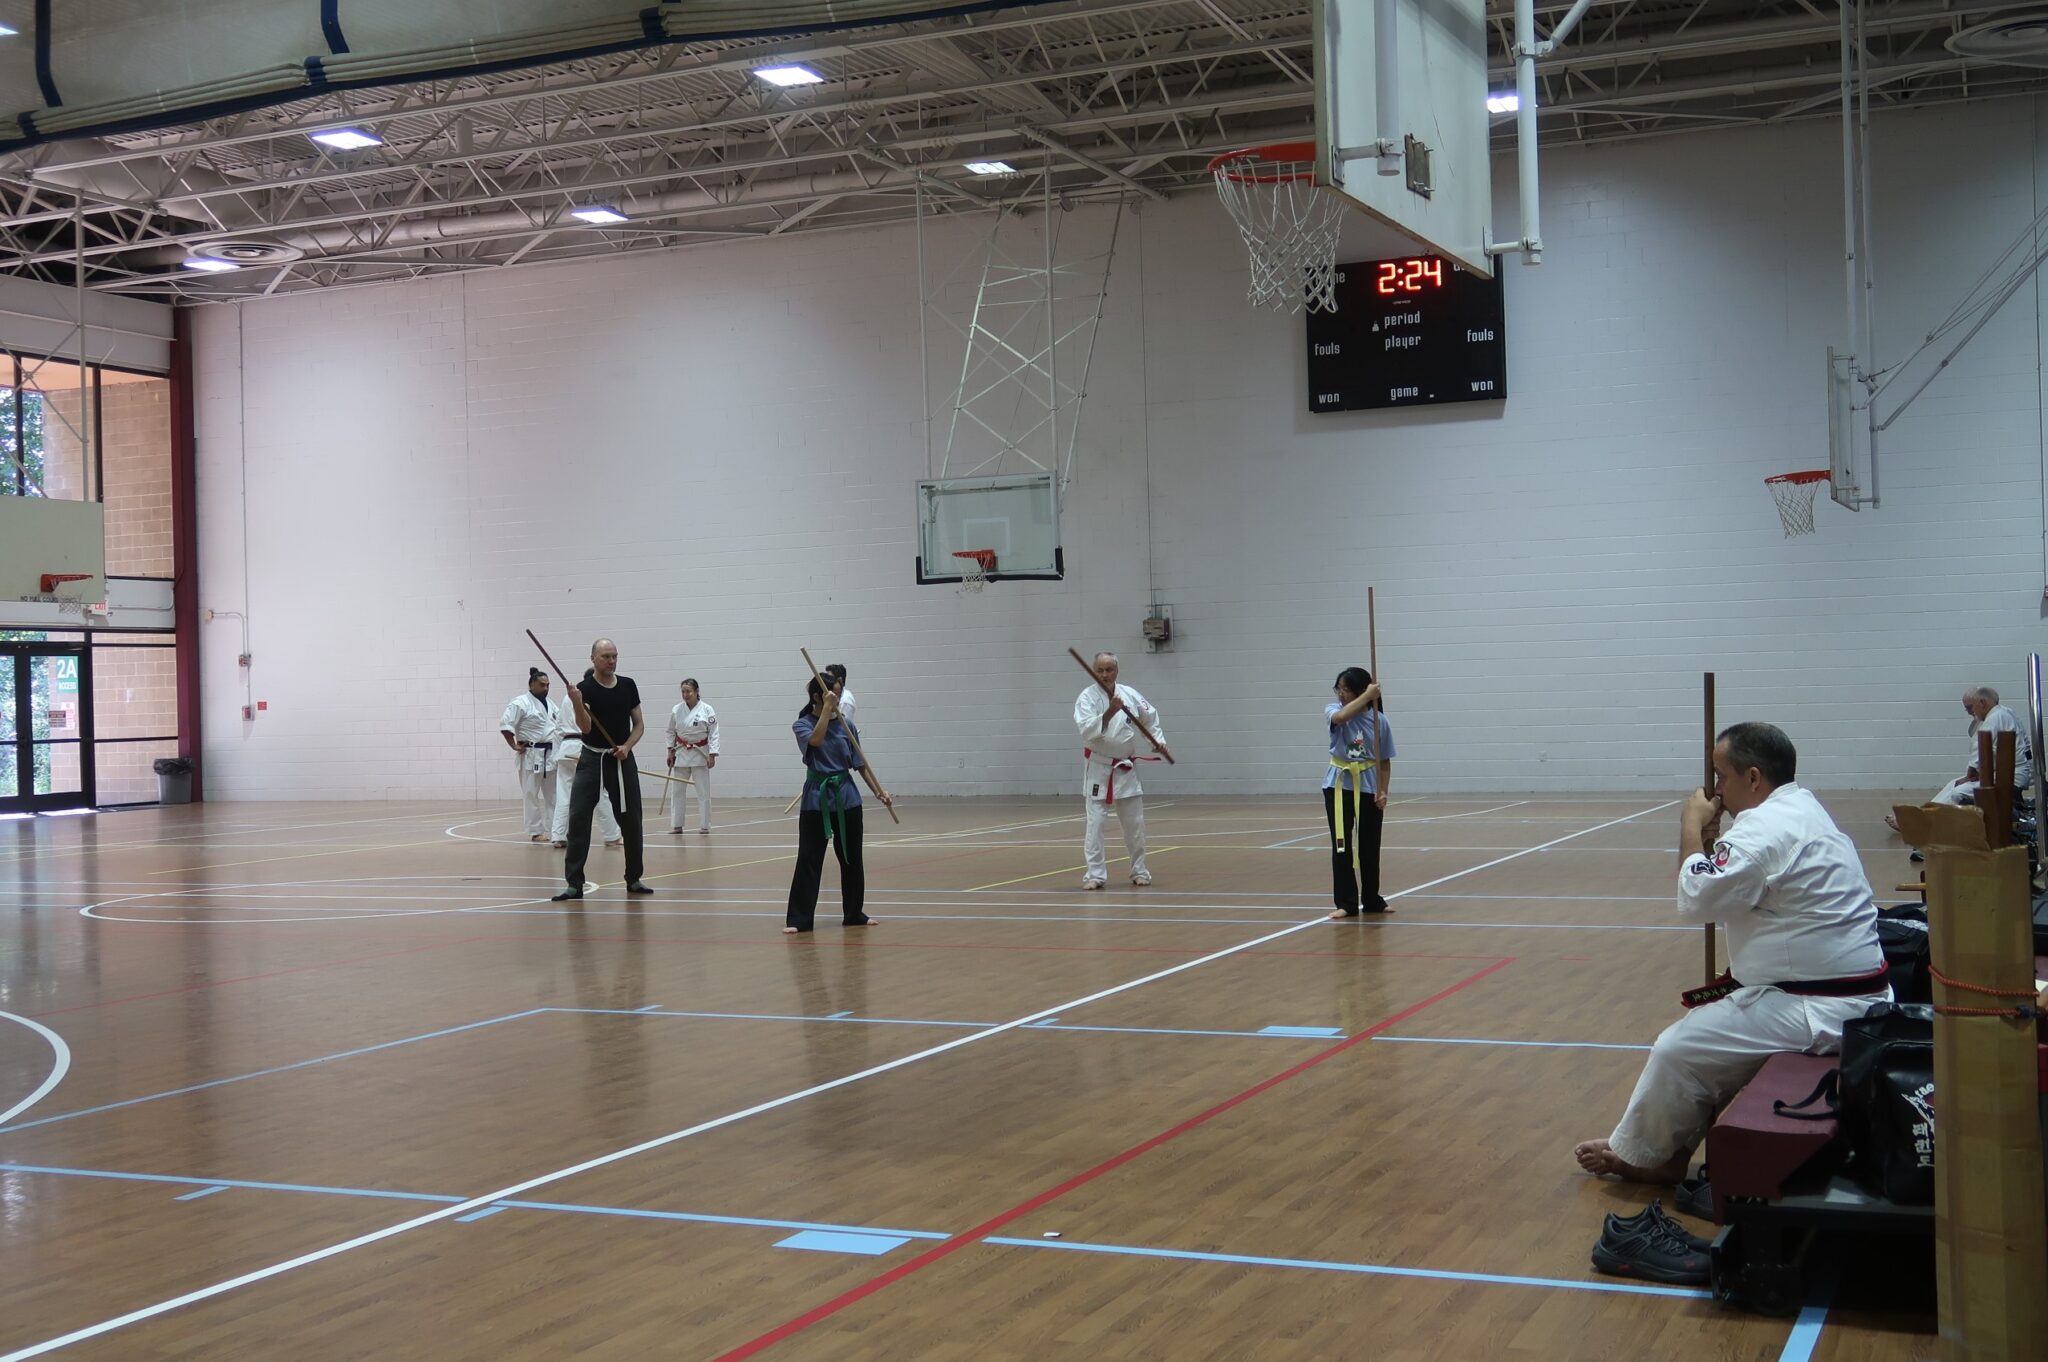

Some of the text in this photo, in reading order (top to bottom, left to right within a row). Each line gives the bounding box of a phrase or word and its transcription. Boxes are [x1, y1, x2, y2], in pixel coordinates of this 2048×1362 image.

[1379, 259, 1442, 293] 2:24
[1384, 311, 1421, 329] period
[1385, 335, 1422, 351] player
[1467, 328, 1494, 343] fouls
[1315, 342, 1340, 356] fouls
[1390, 386, 1419, 401] game
[1471, 380, 1494, 392] won
[1318, 393, 1340, 404] won
[57, 658, 78, 678] 2A
